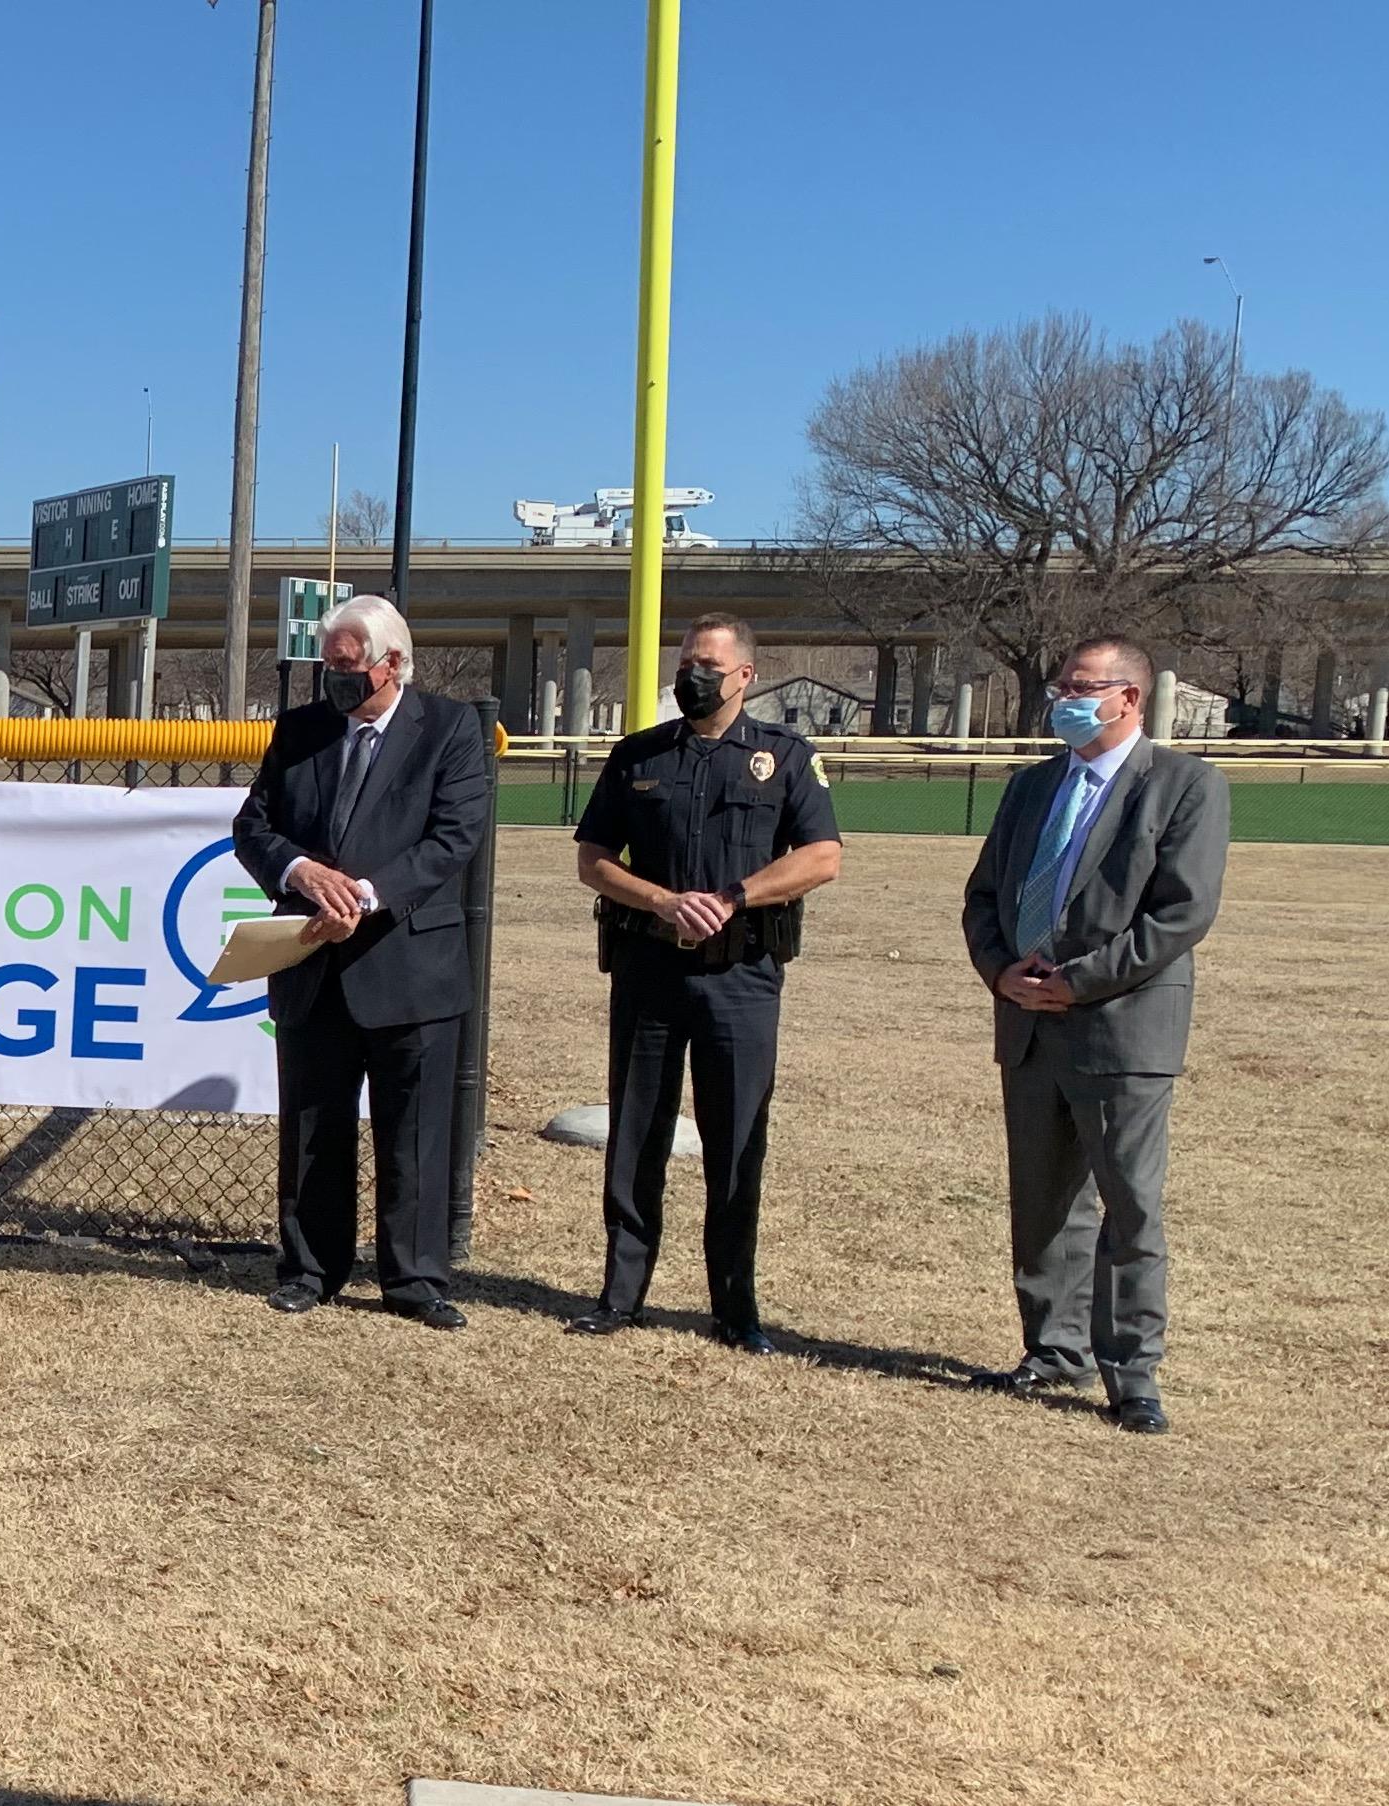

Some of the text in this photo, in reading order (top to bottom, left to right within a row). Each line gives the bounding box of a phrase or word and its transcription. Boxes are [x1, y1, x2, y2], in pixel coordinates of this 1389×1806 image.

[34, 481, 158, 523] VISITOR INNING HOME
[65, 519, 119, 547] H E
[29, 577, 140, 610] BALL STRIKE OUT
